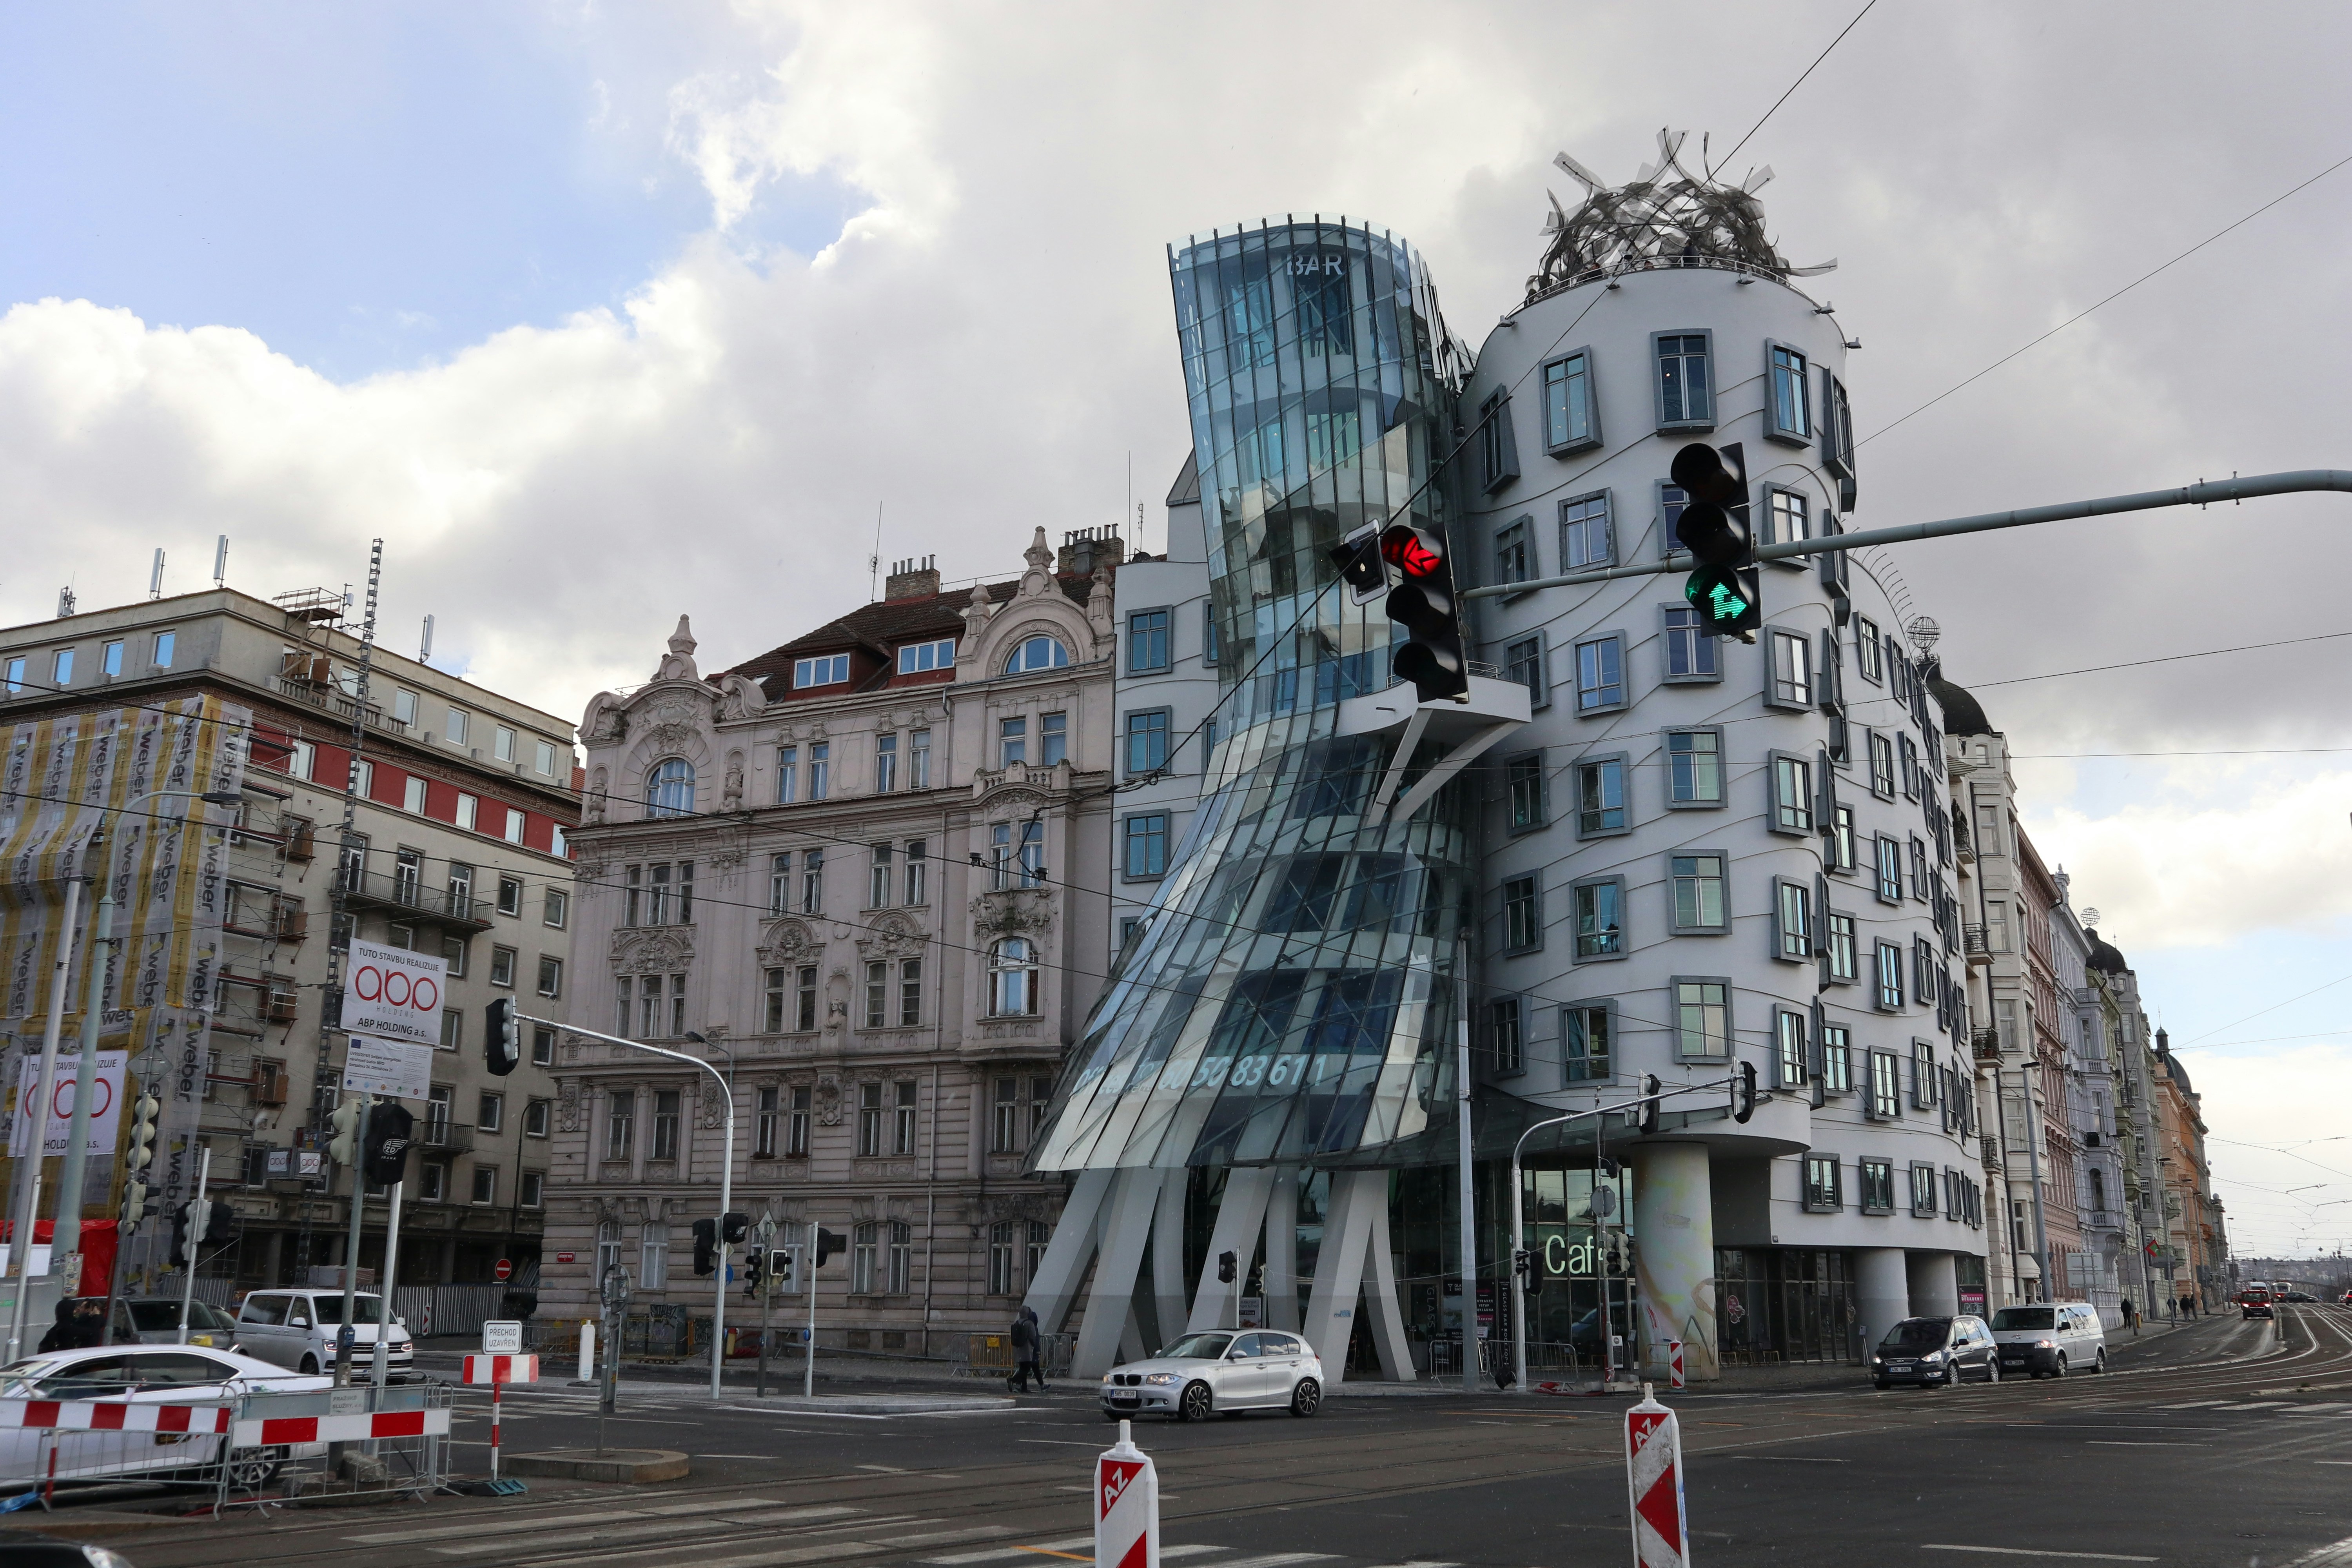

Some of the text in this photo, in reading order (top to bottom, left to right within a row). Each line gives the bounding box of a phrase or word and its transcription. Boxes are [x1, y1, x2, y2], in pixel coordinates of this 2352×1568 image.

[1287, 254, 1343, 275] BAR
[5, 749, 26, 812] weber
[49, 741, 70, 805] weber
[91, 736, 109, 799] weber
[134, 731, 152, 797] weber
[116, 842, 134, 909] weber
[158, 832, 177, 902] weber
[203, 844, 220, 912] weber
[15, 947, 31, 1013] weber
[359, 948, 439, 971] TUTO STAVBU REALIZUJE
[358, 1018, 374, 1028] ABP
[376, 1021, 412, 1034] HOLDING
[377, 1006, 414, 1018] HOLDING
[56, 1061, 78, 1071] TAVBU
[179, 1031, 199, 1103] weber
[163, 1151, 183, 1225] weber
[489, 1327, 517, 1336] PŘECHOD
[489, 1338, 515, 1347] UZAVŘEN
[1634, 1417, 1657, 1450] AZ
[1104, 1466, 1129, 1510] AZ
